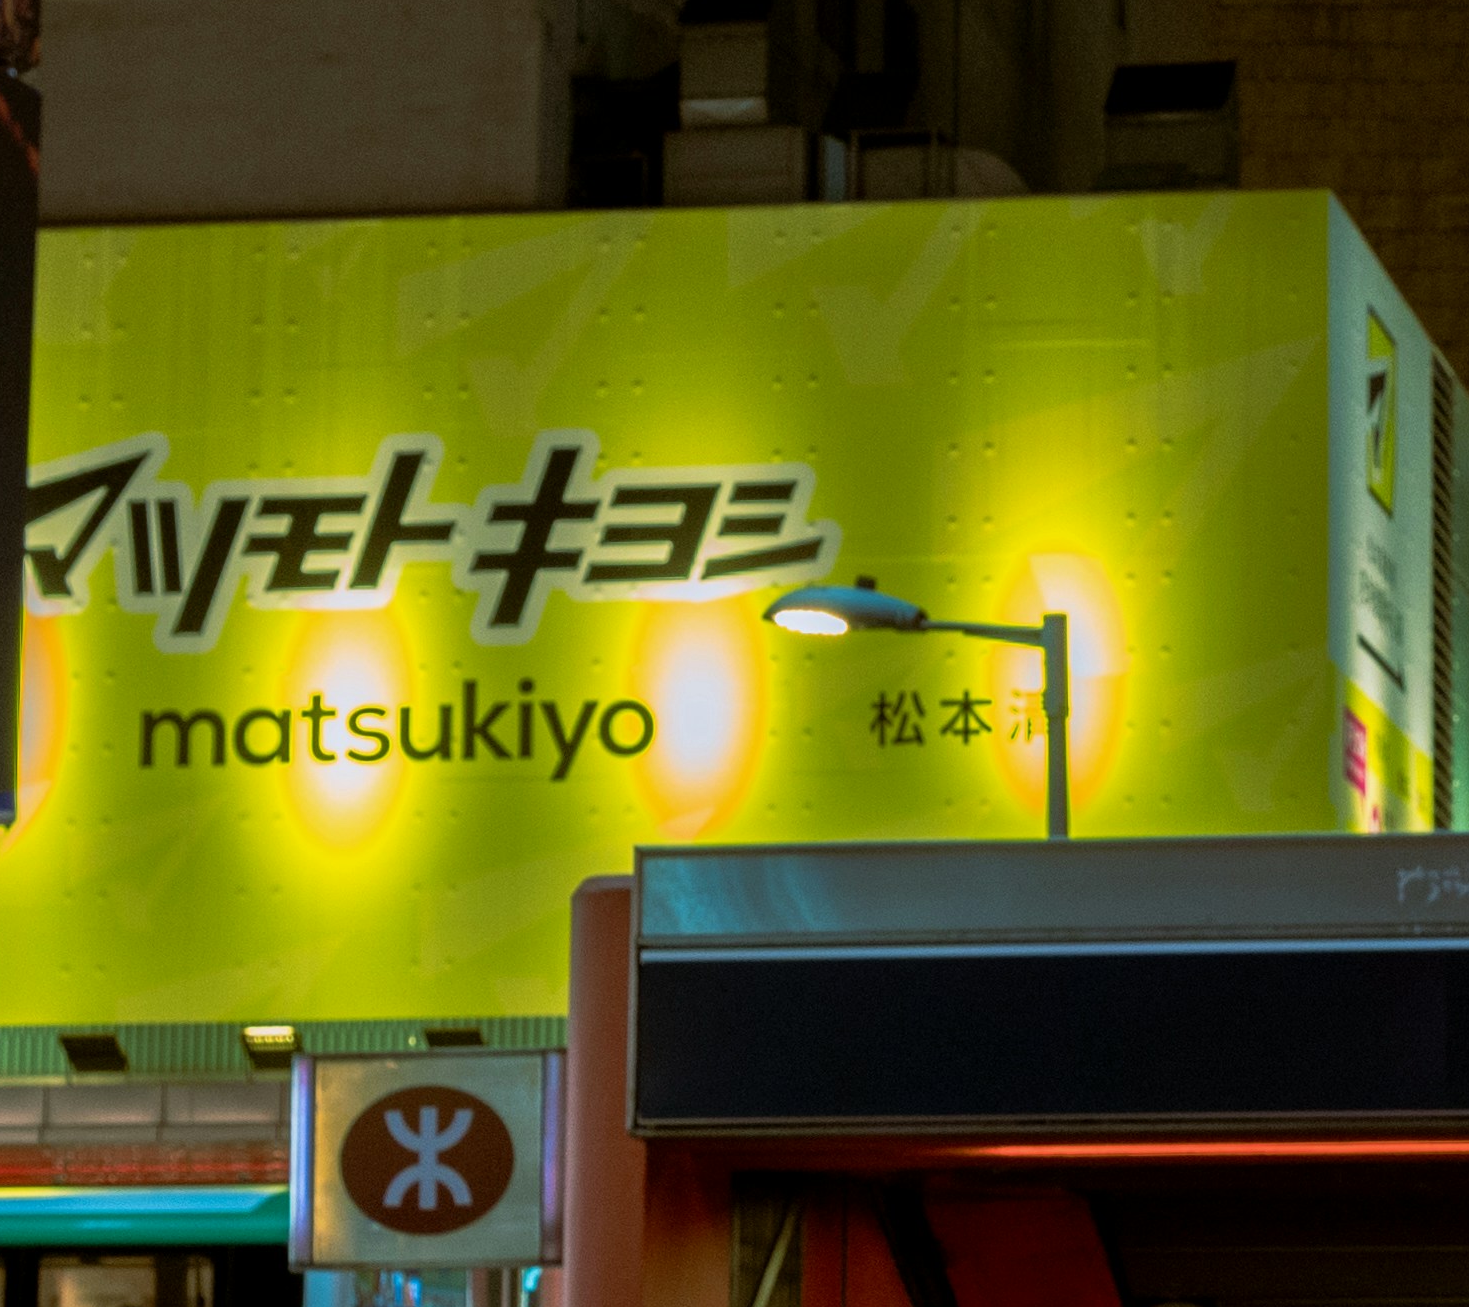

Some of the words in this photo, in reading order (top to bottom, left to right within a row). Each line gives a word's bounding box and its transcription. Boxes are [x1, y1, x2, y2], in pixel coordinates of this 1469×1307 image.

[25, 444, 828, 637] マツモトキヨシ
[139, 678, 656, 783] matsukiyo
